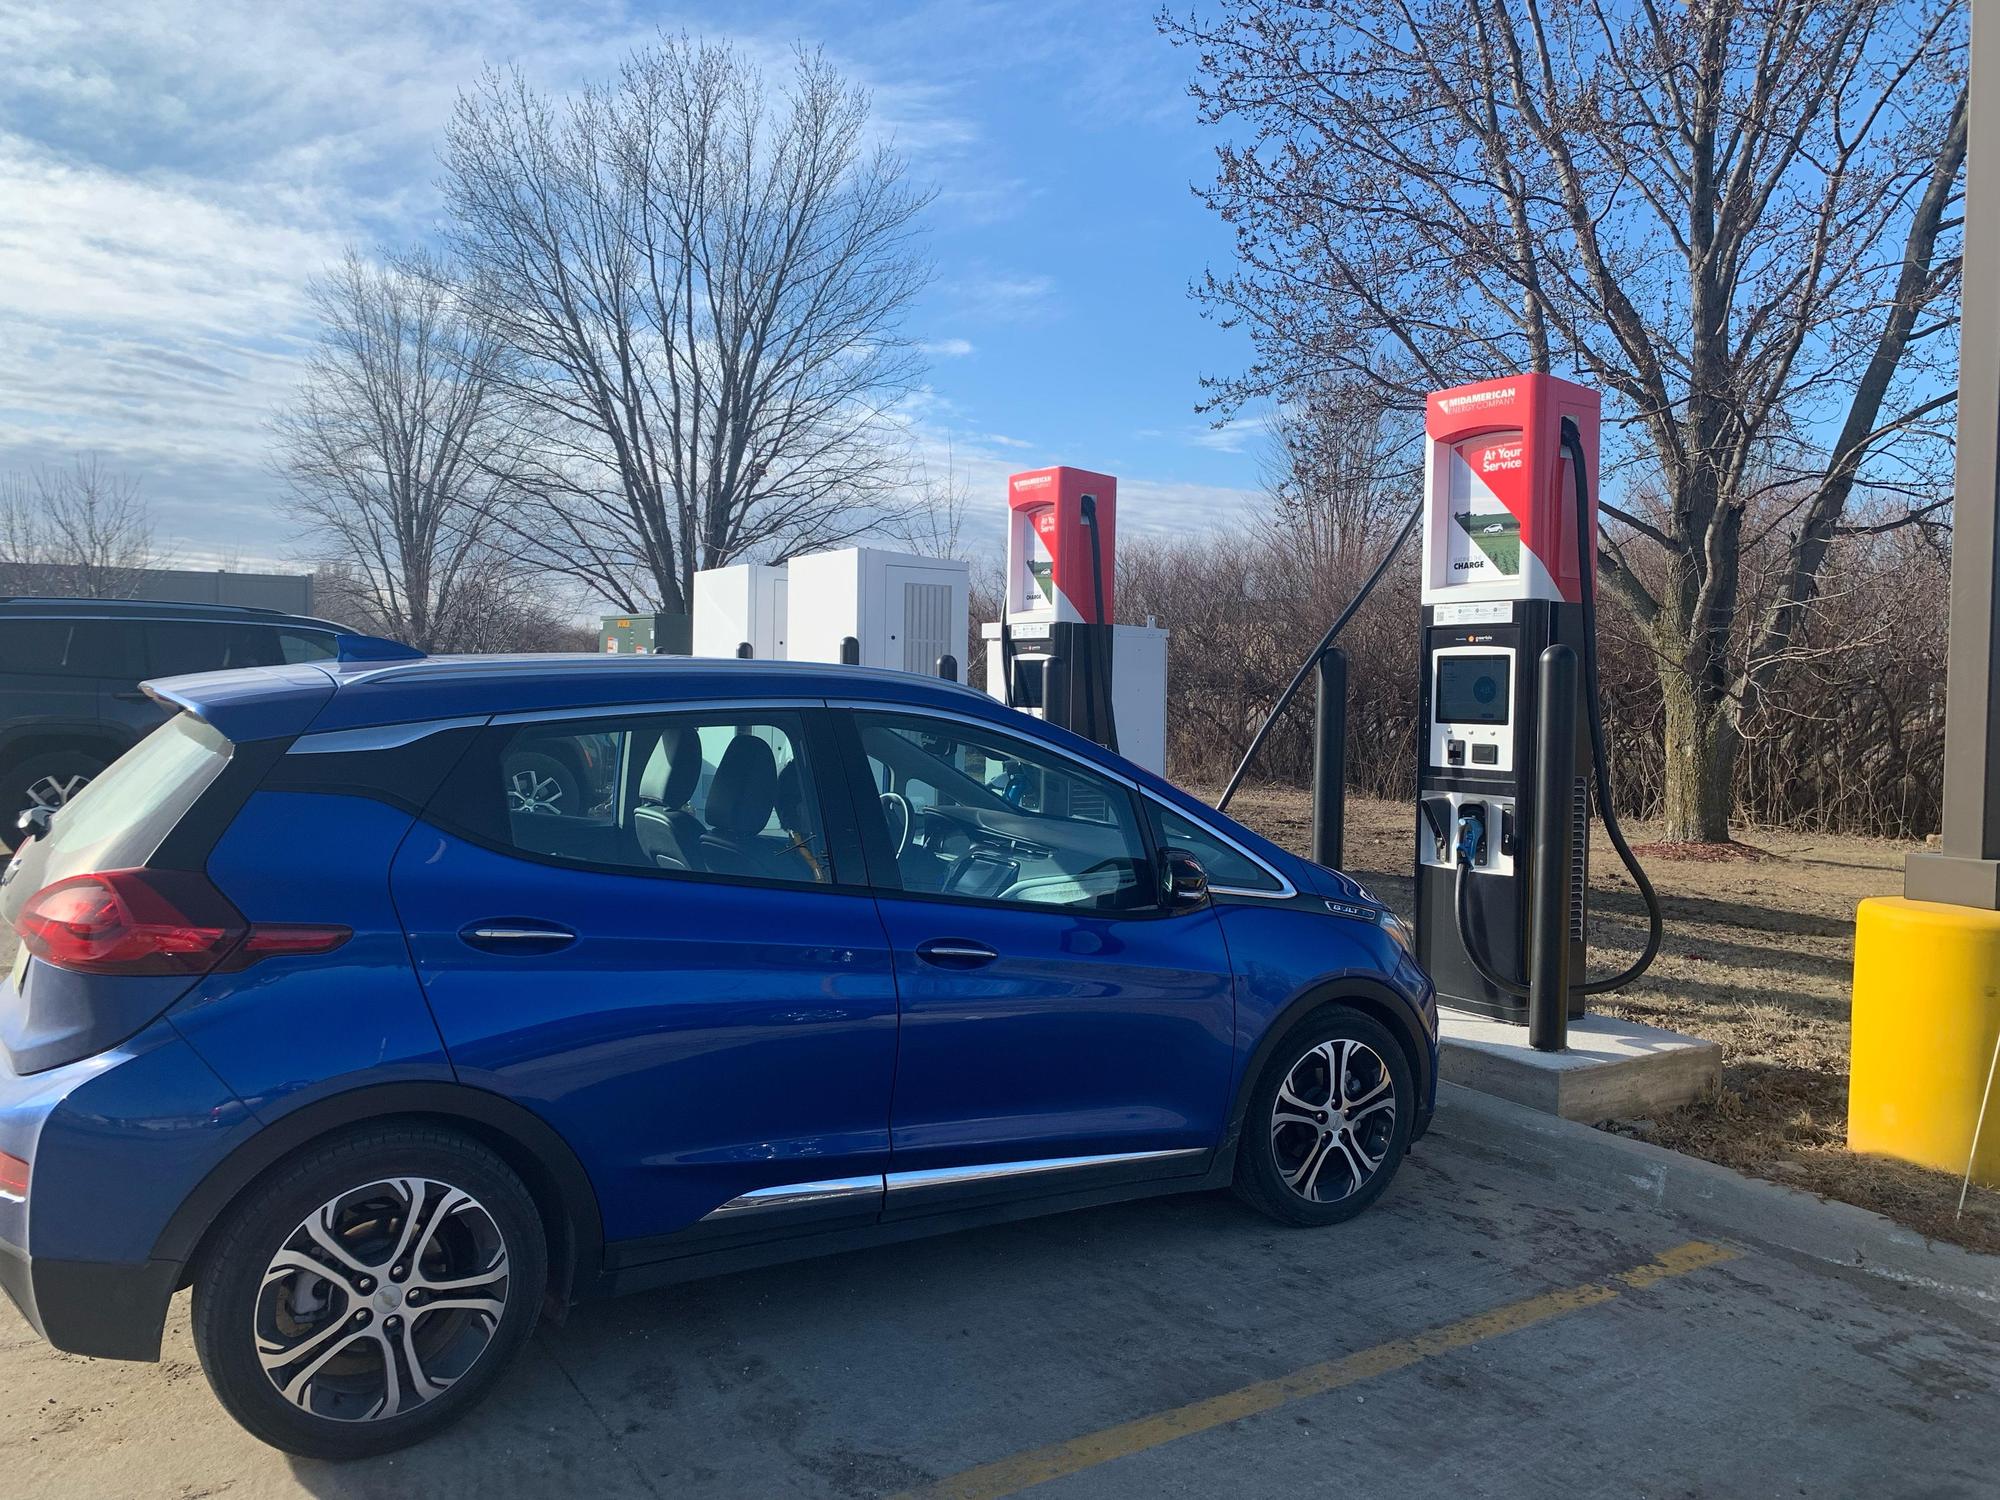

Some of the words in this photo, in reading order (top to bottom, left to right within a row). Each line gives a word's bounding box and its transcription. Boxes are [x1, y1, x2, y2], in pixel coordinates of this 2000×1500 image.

[1449, 388, 1515, 407] MIDAMERICAN
[1449, 403, 1475, 414] ENERGY
[1476, 398, 1515, 410] COMPANY
[1483, 450, 1496, 461] At
[1498, 448, 1522, 460] Your
[1483, 458, 1522, 472] Service
[1453, 561, 1484, 570] CHARGE
